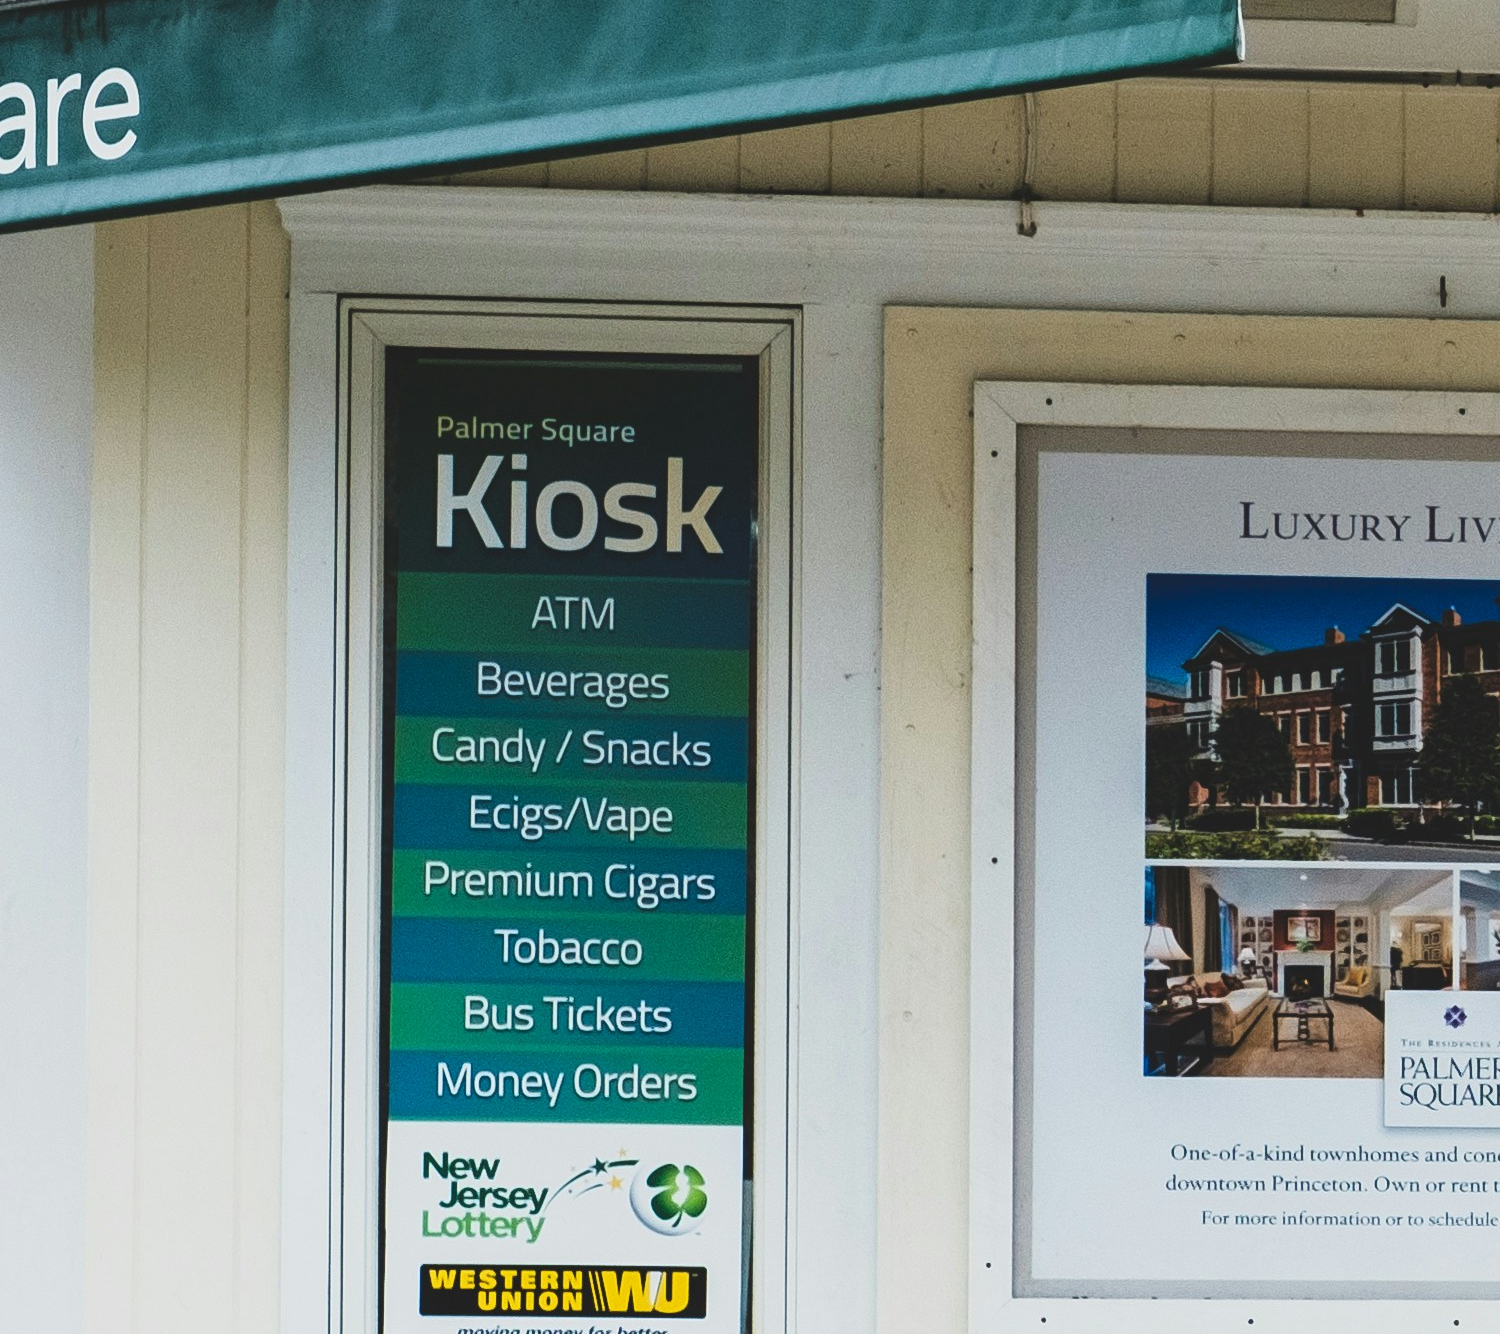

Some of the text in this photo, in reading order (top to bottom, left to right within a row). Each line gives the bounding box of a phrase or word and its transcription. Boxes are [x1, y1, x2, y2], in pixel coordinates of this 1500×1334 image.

[0, 68, 139, 174] are
[438, 416, 634, 447] Palmer Square
[437, 454, 723, 553] Kiosk
[1240, 502, 1410, 541] LUXURY
[532, 597, 614, 629] ATM
[478, 662, 669, 707] Beverages
[433, 728, 710, 772] Candy / Snacks
[471, 795, 672, 840] Ecigs/Vape
[425, 861, 715, 908] Premium Cigars
[495, 929, 642, 964] Tobacco
[465, 996, 671, 1032] Bus Tickets
[438, 1063, 696, 1106] Money Orders
[423, 1152, 500, 1179] New
[1171, 1144, 1303, 1161] One-of-a-kind
[1311, 1146, 1418, 1161] townhomes
[1425, 1146, 1457, 1162] and
[439, 1181, 548, 1214] Jersey
[1166, 1175, 1265, 1190] downtown
[1272, 1176, 1368, 1192] Princeton.
[1375, 1177, 1419, 1191] Own
[1426, 1182, 1445, 1192] or
[1452, 1182, 1486, 1192] rent
[422, 1210, 546, 1243] Lottery
[1203, 1211, 1229, 1224] For
[1236, 1215, 1276, 1225] more
[1283, 1212, 1380, 1225] information
[1386, 1217, 1403, 1225] or
[1408, 1216, 1424, 1225] to
[1429, 1212, 1498, 1226] schedule
[429, 1270, 582, 1289] WESTERN
[478, 1291, 582, 1311] UNION
